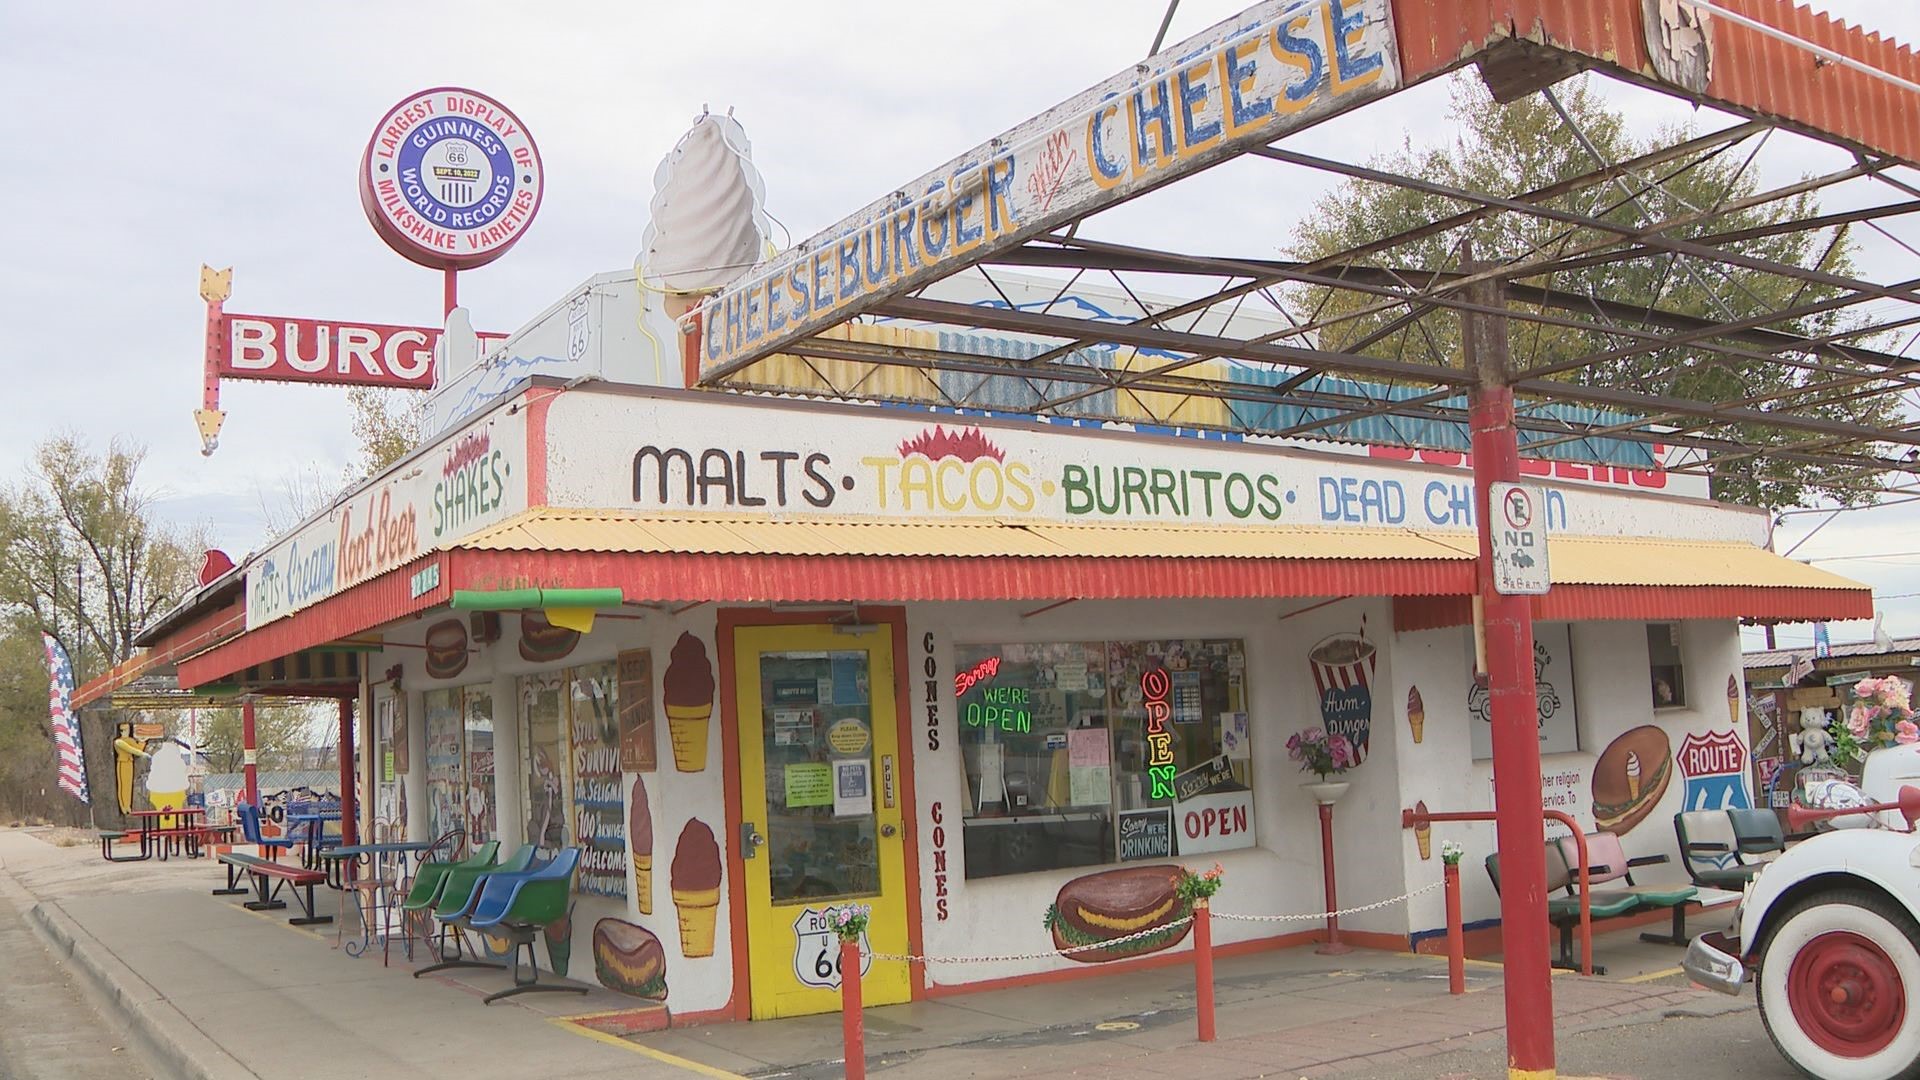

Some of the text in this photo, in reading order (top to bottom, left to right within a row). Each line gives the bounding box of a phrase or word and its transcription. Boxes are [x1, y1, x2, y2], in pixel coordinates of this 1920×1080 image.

[378, 97, 533, 169] LARGEST DISPLAY OF
[413, 121, 501, 156] GUINNESS
[436, 168, 453, 176] SEPT.
[449, 153, 465, 163] 66
[403, 168, 510, 227] WORLD RECORDS
[702, 148, 1018, 369] CHEESEBURGER
[1086, 0, 1386, 190] CHEESE
[378, 179, 533, 249] MILKSHAKE VARIETIES
[231, 319, 437, 380] BURG
[572, 330, 584, 357] 66
[633, 445, 836, 508] MALTS
[861, 455, 1034, 512] TACOS
[1062, 464, 1283, 519] BURRITOS
[1319, 476, 1405, 524] DEAD
[254, 450, 503, 620] MALTS Creamy Root Beer SHAKES
[1505, 531, 1534, 546] NO
[923, 632, 940, 751] CONES
[955, 657, 1000, 696] Sorry
[983, 686, 1030, 704] WE'RE
[1325, 690, 1366, 713] Hum-
[967, 703, 1031, 734] OPEN
[1141, 667, 1176, 799] OPEN
[578, 747, 622, 774] SURVIVI
[1689, 744, 1738, 773] ROUTE
[588, 778, 624, 802] SELIGMA
[884, 764, 892, 800] PULL
[1542, 770, 1580, 788] her religion
[1543, 793, 1567, 807] ervice.
[1121, 817, 1147, 837] Sorry
[1184, 805, 1247, 839] OPEN
[931, 802, 949, 921] CONES
[1121, 836, 1168, 857] DRINKING
